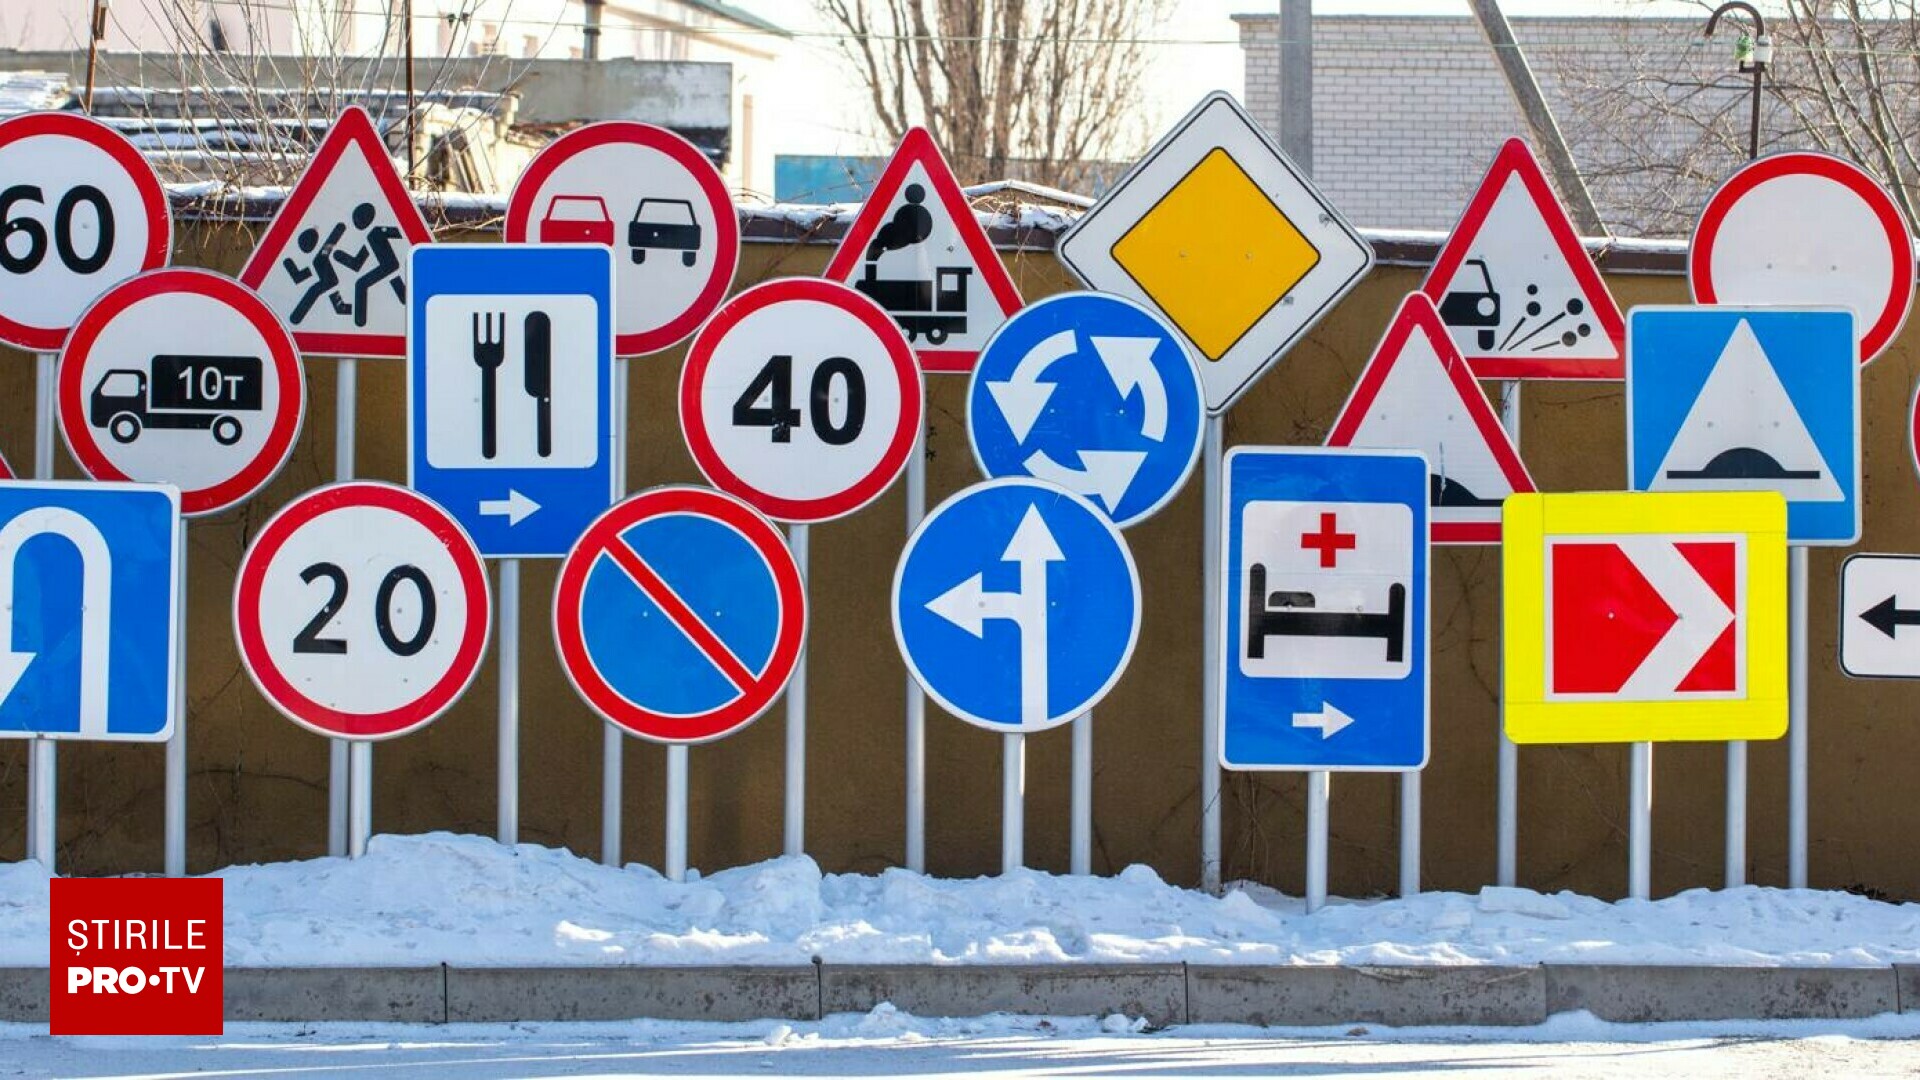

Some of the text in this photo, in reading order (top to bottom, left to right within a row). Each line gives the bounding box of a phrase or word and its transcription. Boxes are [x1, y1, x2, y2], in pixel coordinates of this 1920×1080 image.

[0, 184, 116, 275] 60
[732, 355, 867, 446] 40
[292, 561, 437, 657] 20
